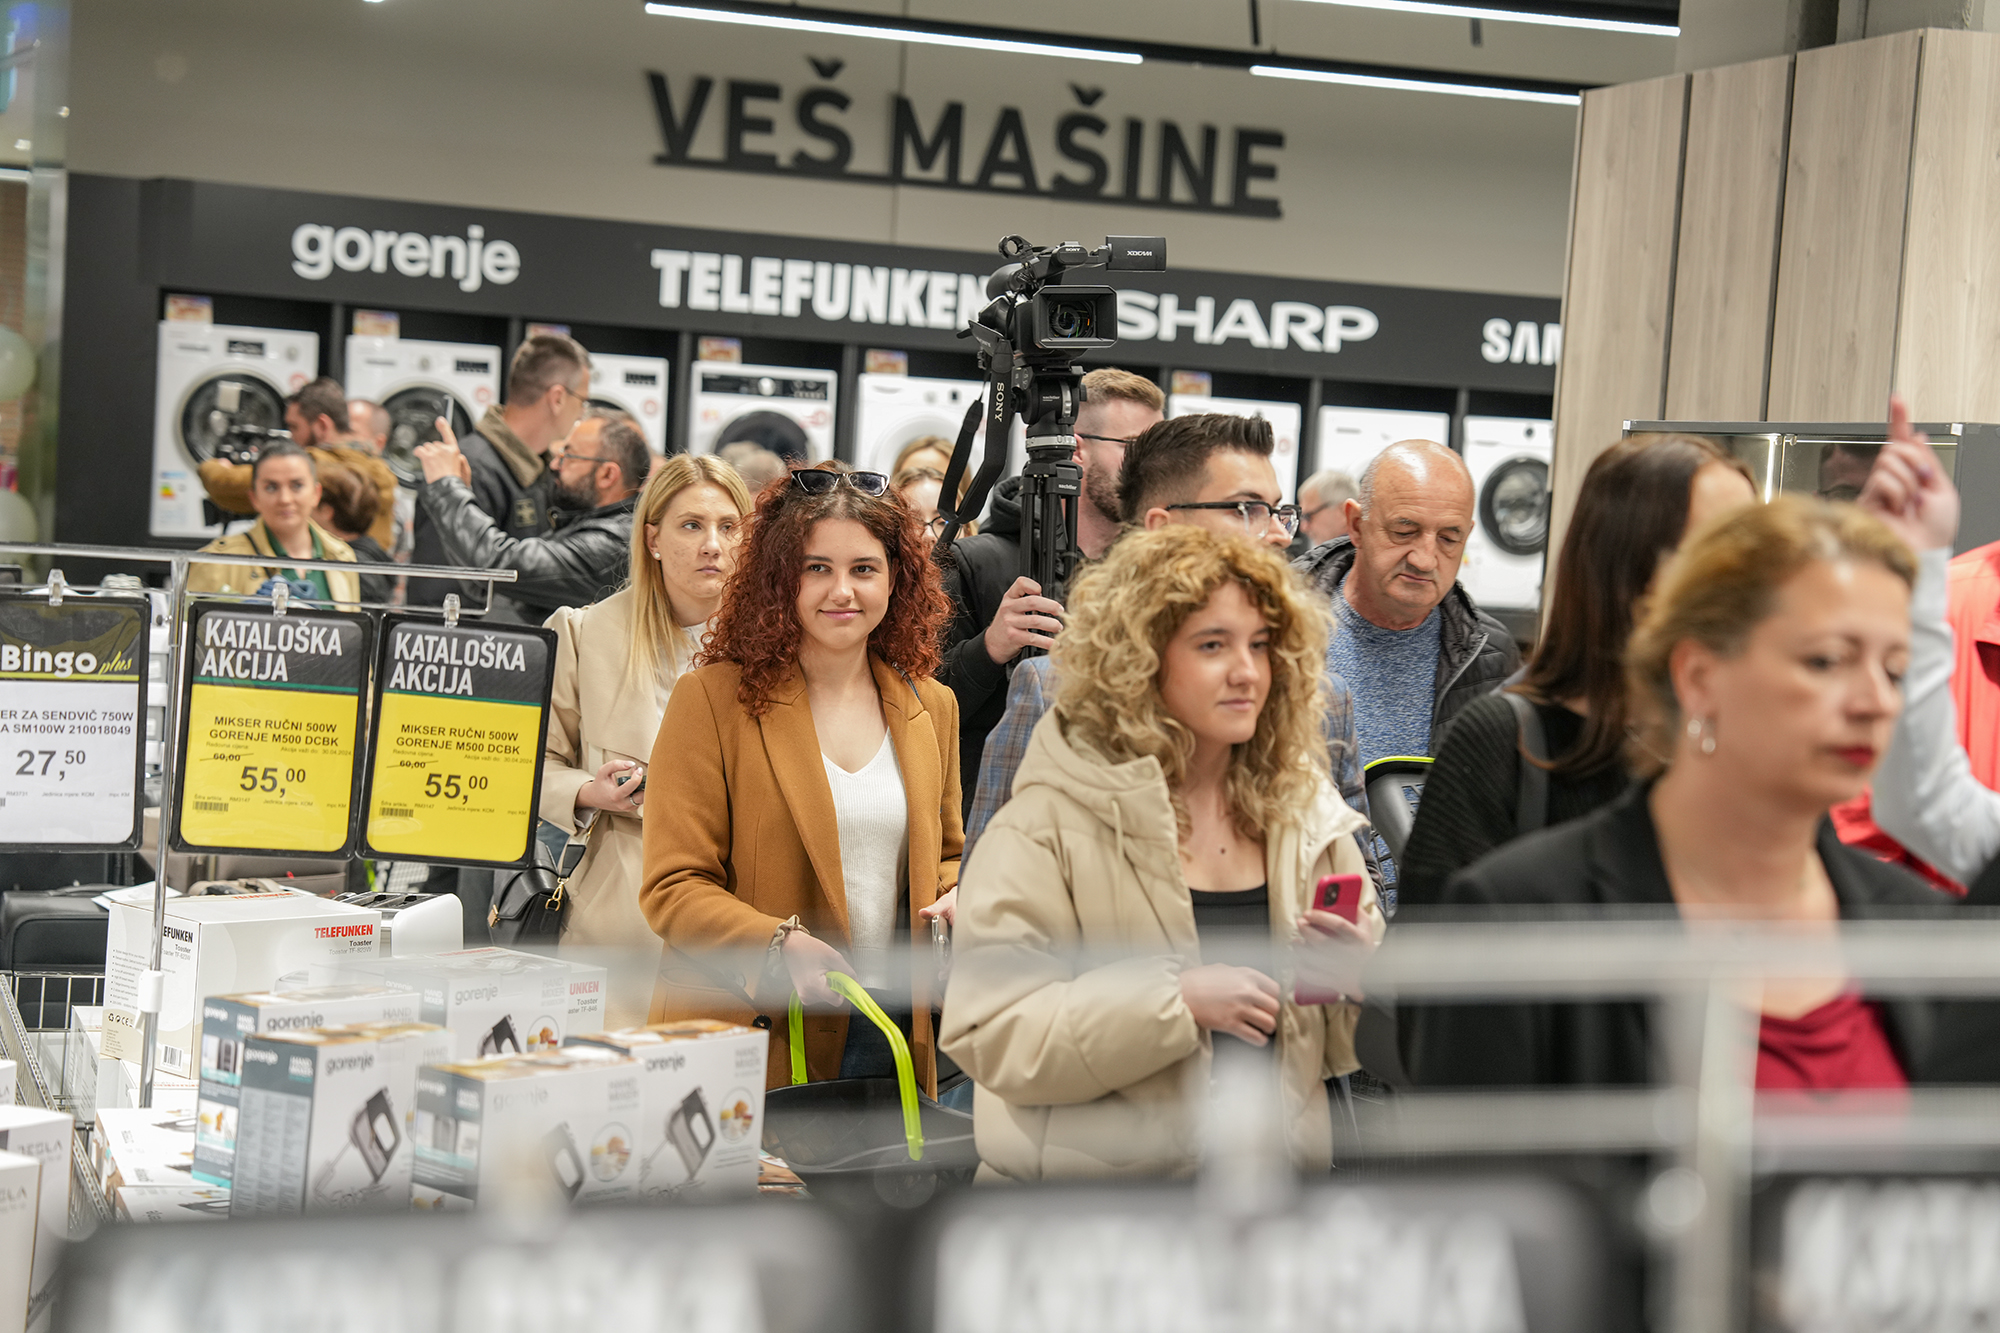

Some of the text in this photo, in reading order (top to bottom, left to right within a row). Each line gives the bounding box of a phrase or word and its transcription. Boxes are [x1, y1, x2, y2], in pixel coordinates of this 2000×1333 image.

[646, 56, 1286, 216] VEŠ MAŠINE
[291, 223, 521, 292] gorenje
[1116, 289, 1379, 353] SHARP
[995, 382, 1005, 422] SONY
[205, 618, 343, 656] KATALOŠKA
[1, 643, 132, 678] Bingo plus
[394, 632, 526, 672] KATALOŠKA
[200, 648, 288, 682] AKCIJA
[389, 661, 474, 696] AKCIJA
[21, 711, 38, 720] ZA
[42, 709, 97, 721] SENDVIČ
[102, 712, 134, 721] 750W
[13, 725, 65, 734] SM100W
[69, 725, 131, 735] 210018049
[214, 716, 337, 733] MIKSER RUČNI 500W
[401, 724, 519, 741] MIKSER RUČNI 500W
[209, 729, 339, 746] GORENJE M500 DCBK
[396, 737, 520, 755] GORENJE M500 DCBK
[213, 753, 241, 762] 60,00
[399, 760, 426, 769] 60,00
[163, 926, 194, 943] EFUNKEN
[314, 924, 373, 939] TELEFUNKEN
[175, 943, 191, 954] Toaster
[349, 939, 372, 947] Toaster
[329, 948, 348, 956] Toaster
[455, 983, 498, 1006] gorenje
[577, 998, 598, 1006] Toaster
[204, 1006, 228, 1022] gorenje
[267, 1011, 324, 1032] gorenje
[383, 1007, 412, 1019] HAND
[244, 1047, 278, 1065] gorenje
[325, 1051, 374, 1075] gorenje
